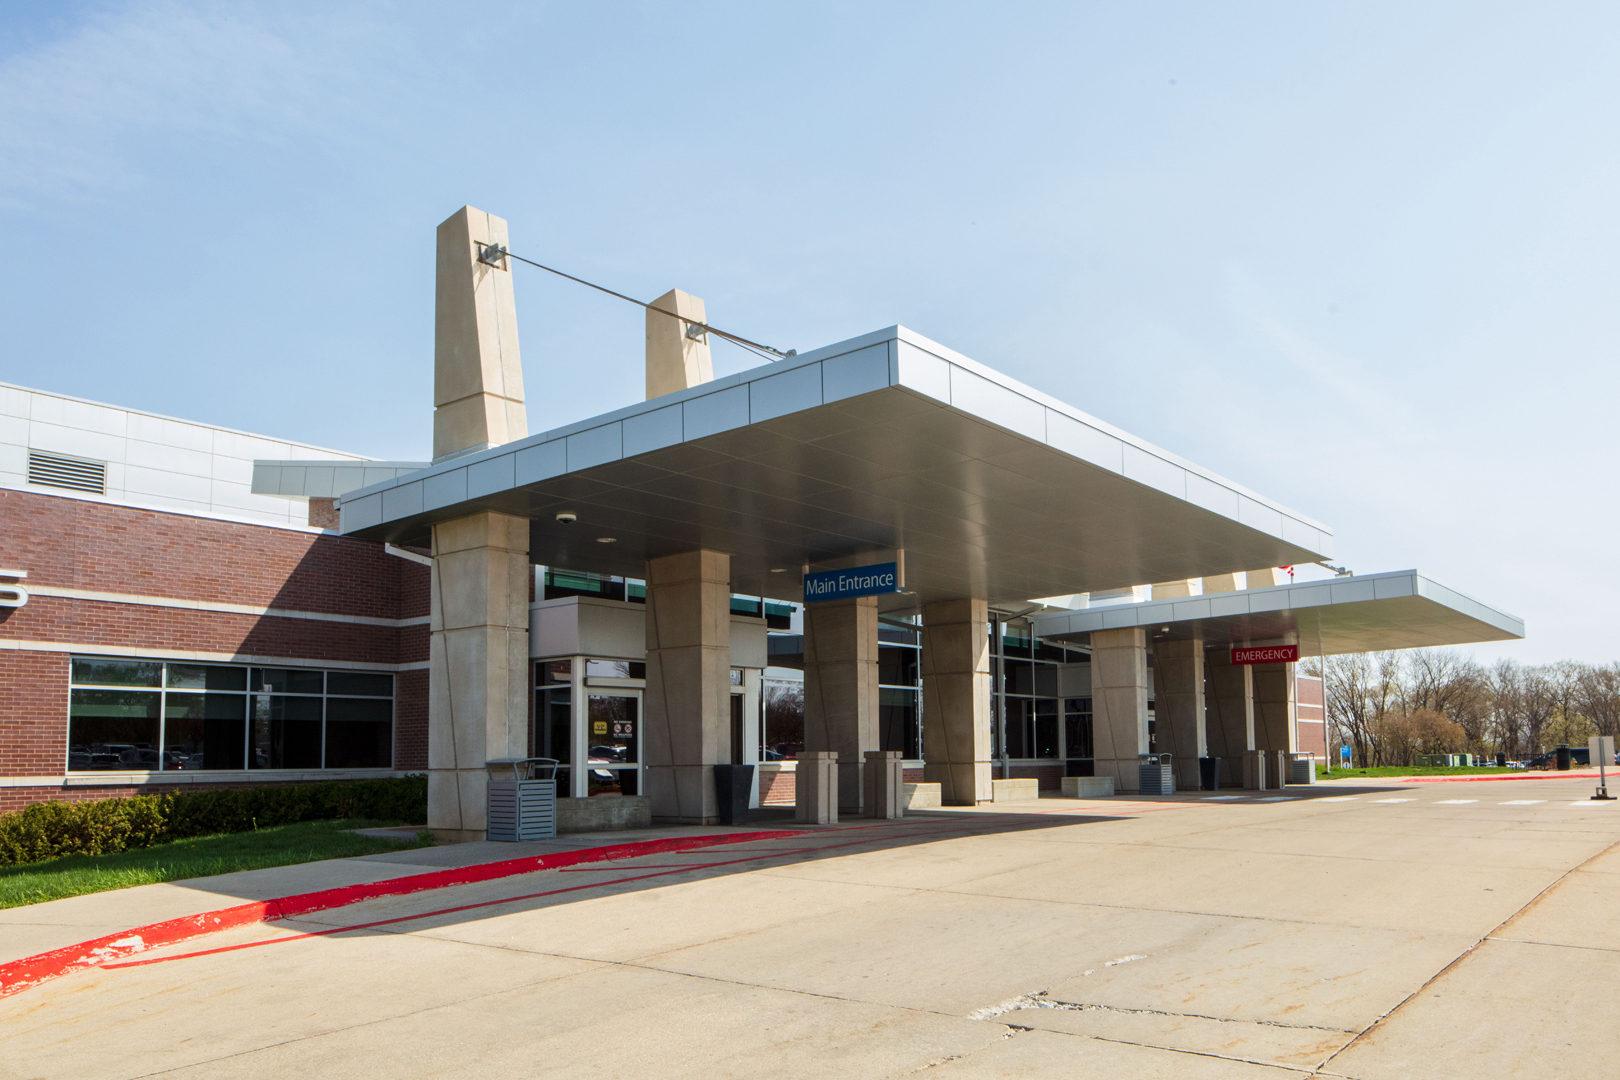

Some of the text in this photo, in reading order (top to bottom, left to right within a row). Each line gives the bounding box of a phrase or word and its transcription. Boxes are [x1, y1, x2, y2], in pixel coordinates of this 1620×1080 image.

[806, 573, 894, 595] Main Entrance
[1235, 649, 1294, 662] EMERGENCY
